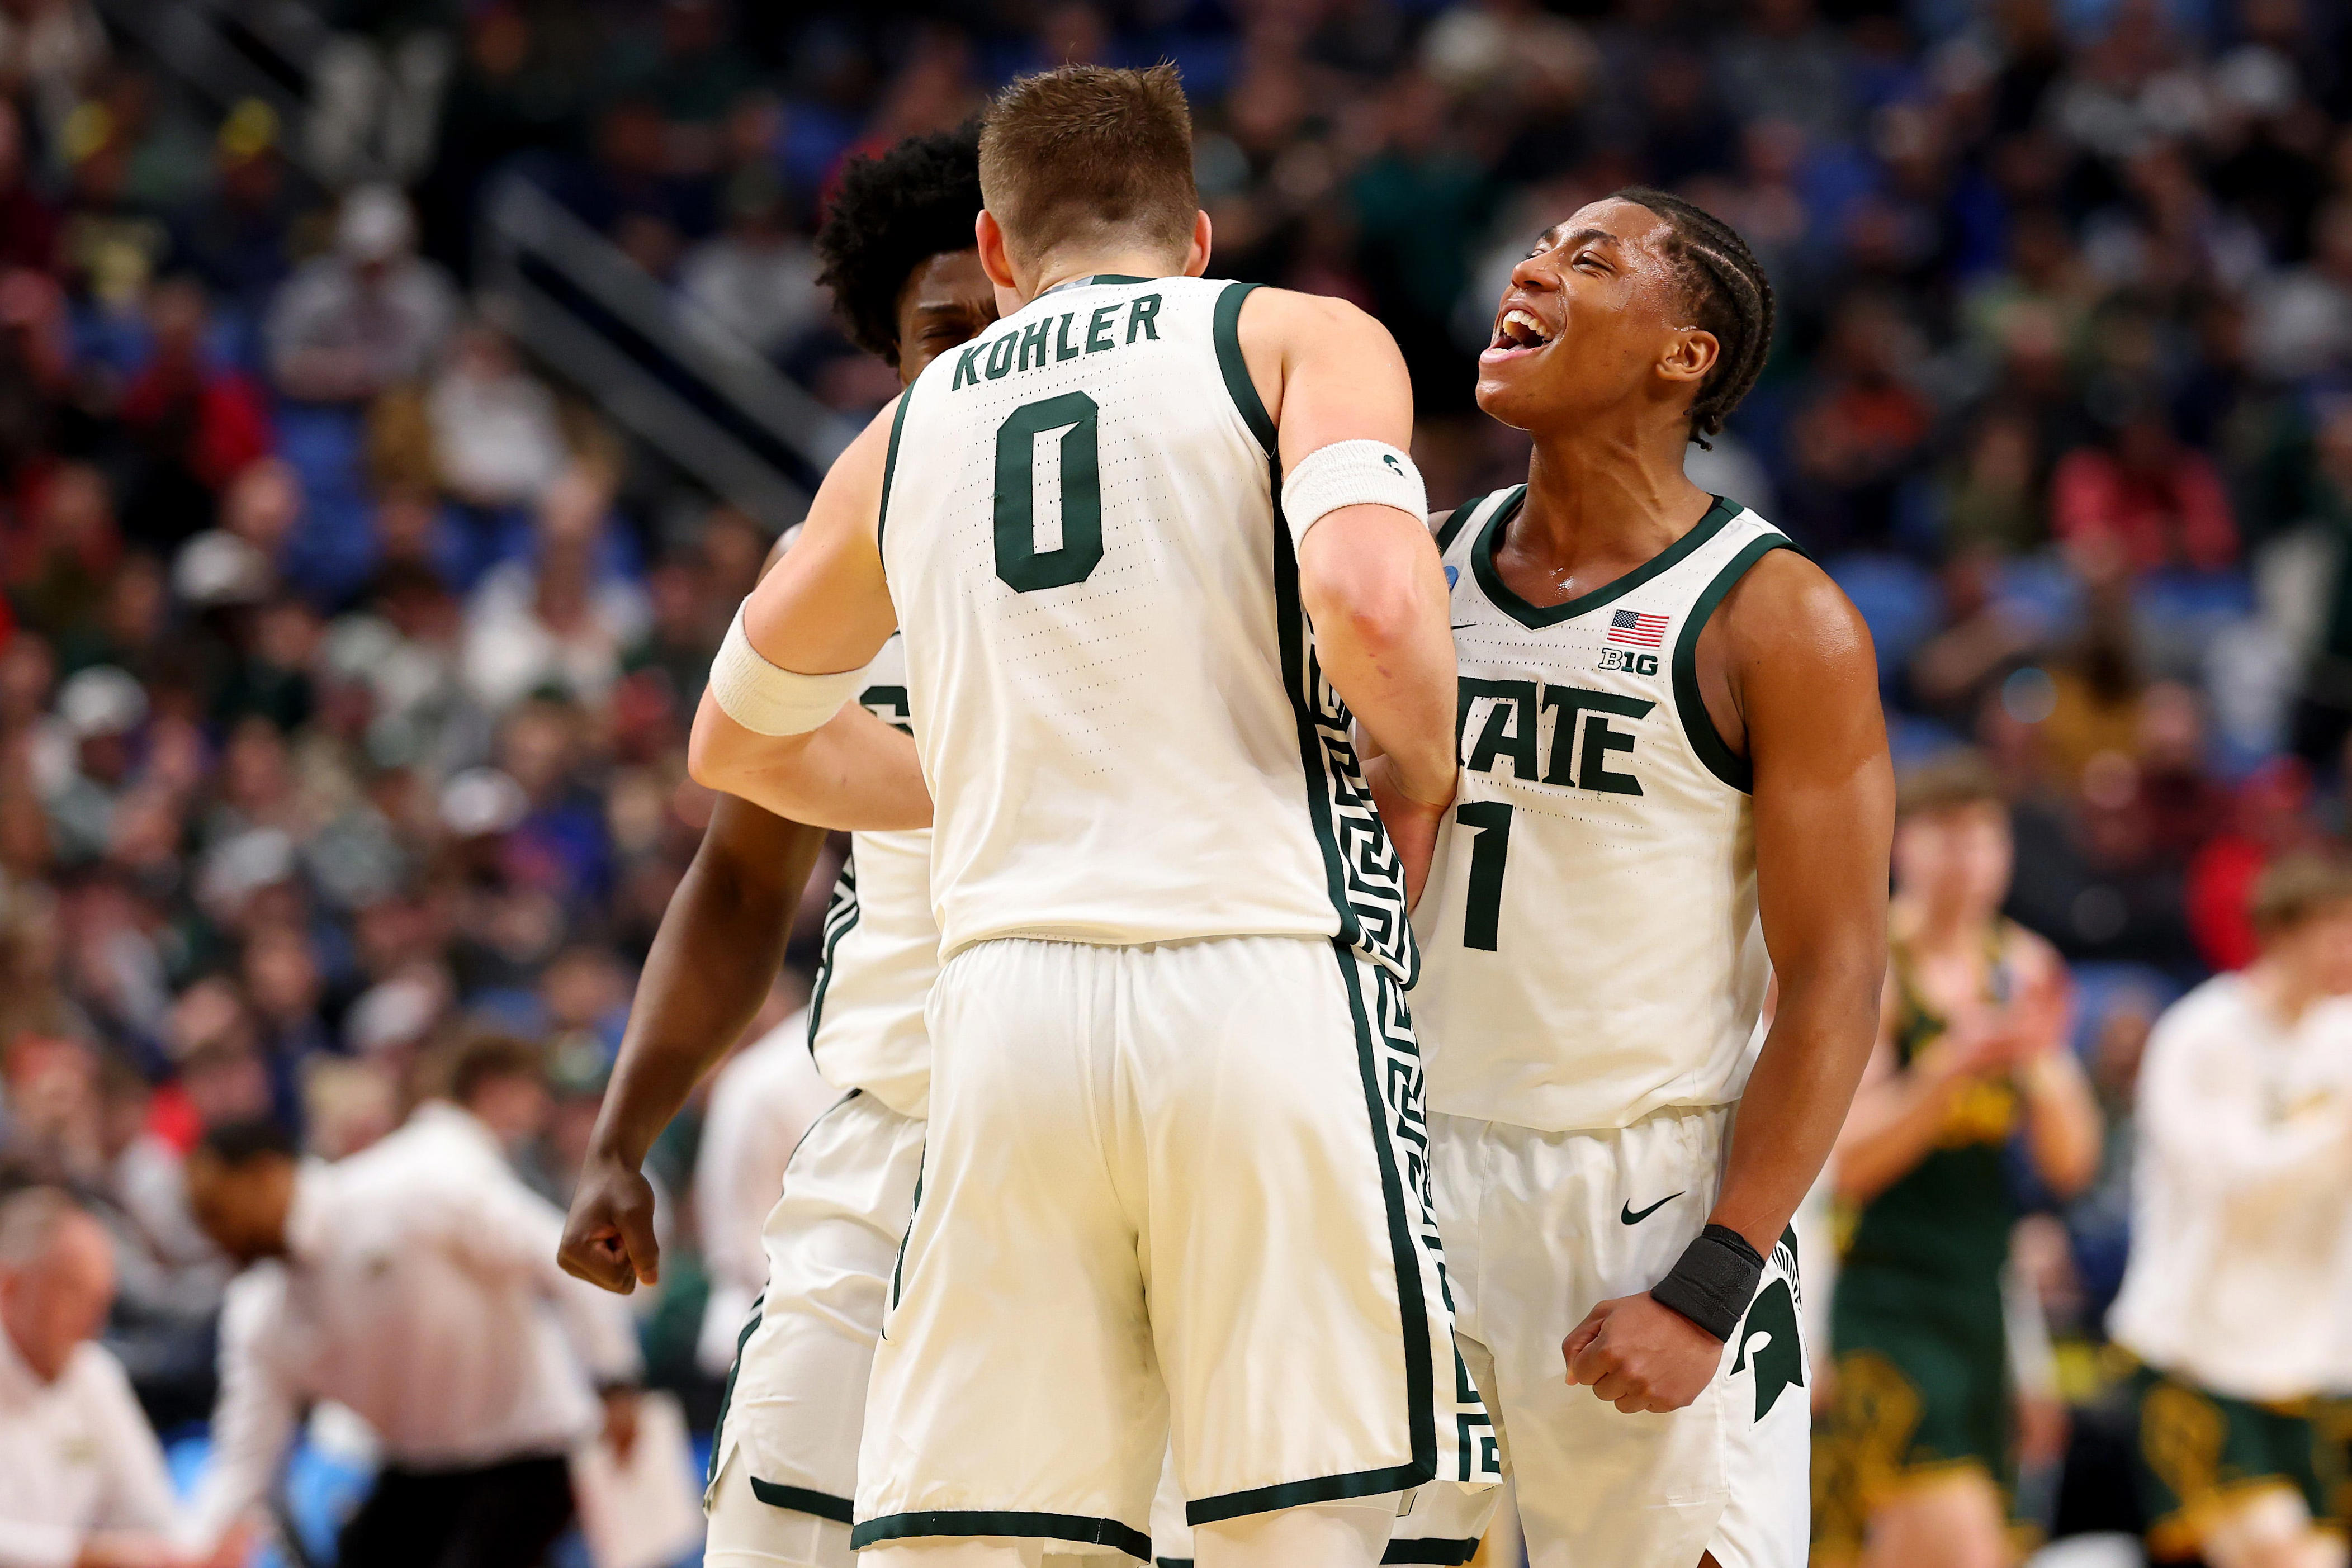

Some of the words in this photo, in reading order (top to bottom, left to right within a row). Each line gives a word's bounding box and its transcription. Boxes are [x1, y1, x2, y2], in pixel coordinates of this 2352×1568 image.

[952, 293, 1162, 391] KOHLER
[993, 390, 1104, 593] 0
[1456, 800, 1513, 952] 1
